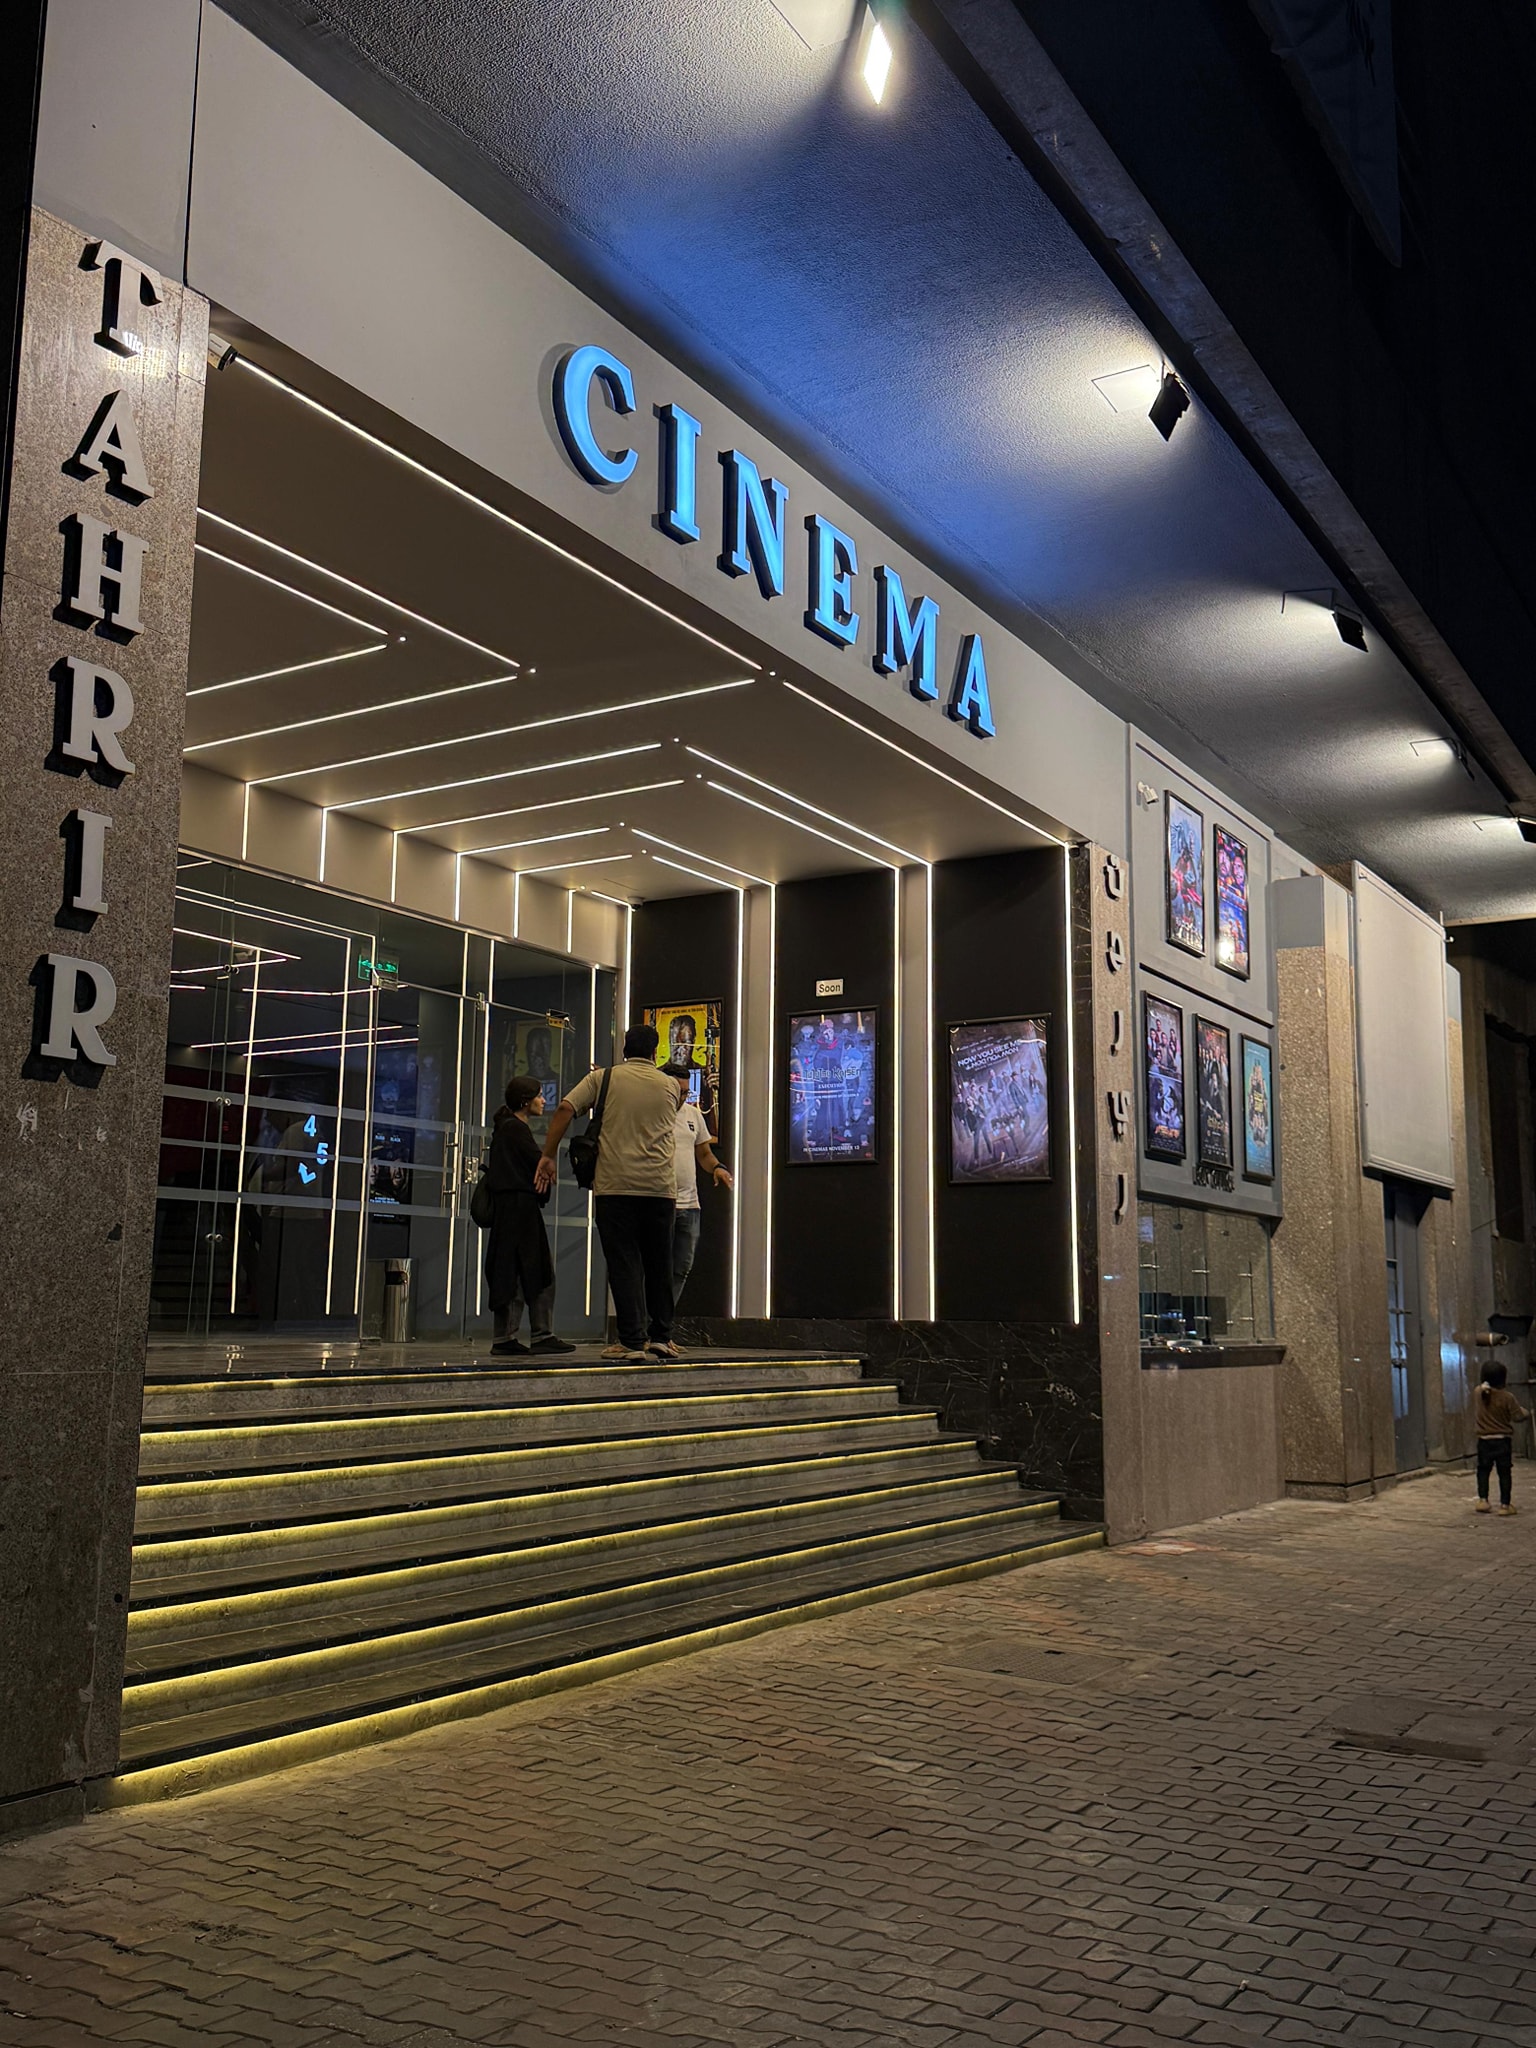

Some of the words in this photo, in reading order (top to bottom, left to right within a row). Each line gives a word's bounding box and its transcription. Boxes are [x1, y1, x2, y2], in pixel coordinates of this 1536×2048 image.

[560, 344, 996, 738] CINEMA
[36, 238, 162, 1072] TAHRIR
[818, 983, 841, 994] Soon
[957, 1054, 977, 1067] NOW
[977, 1048, 994, 1059] YOU
[994, 1043, 1009, 1053] SEE
[303, 1114, 317, 1137] 4
[316, 1142, 329, 1165] 5
